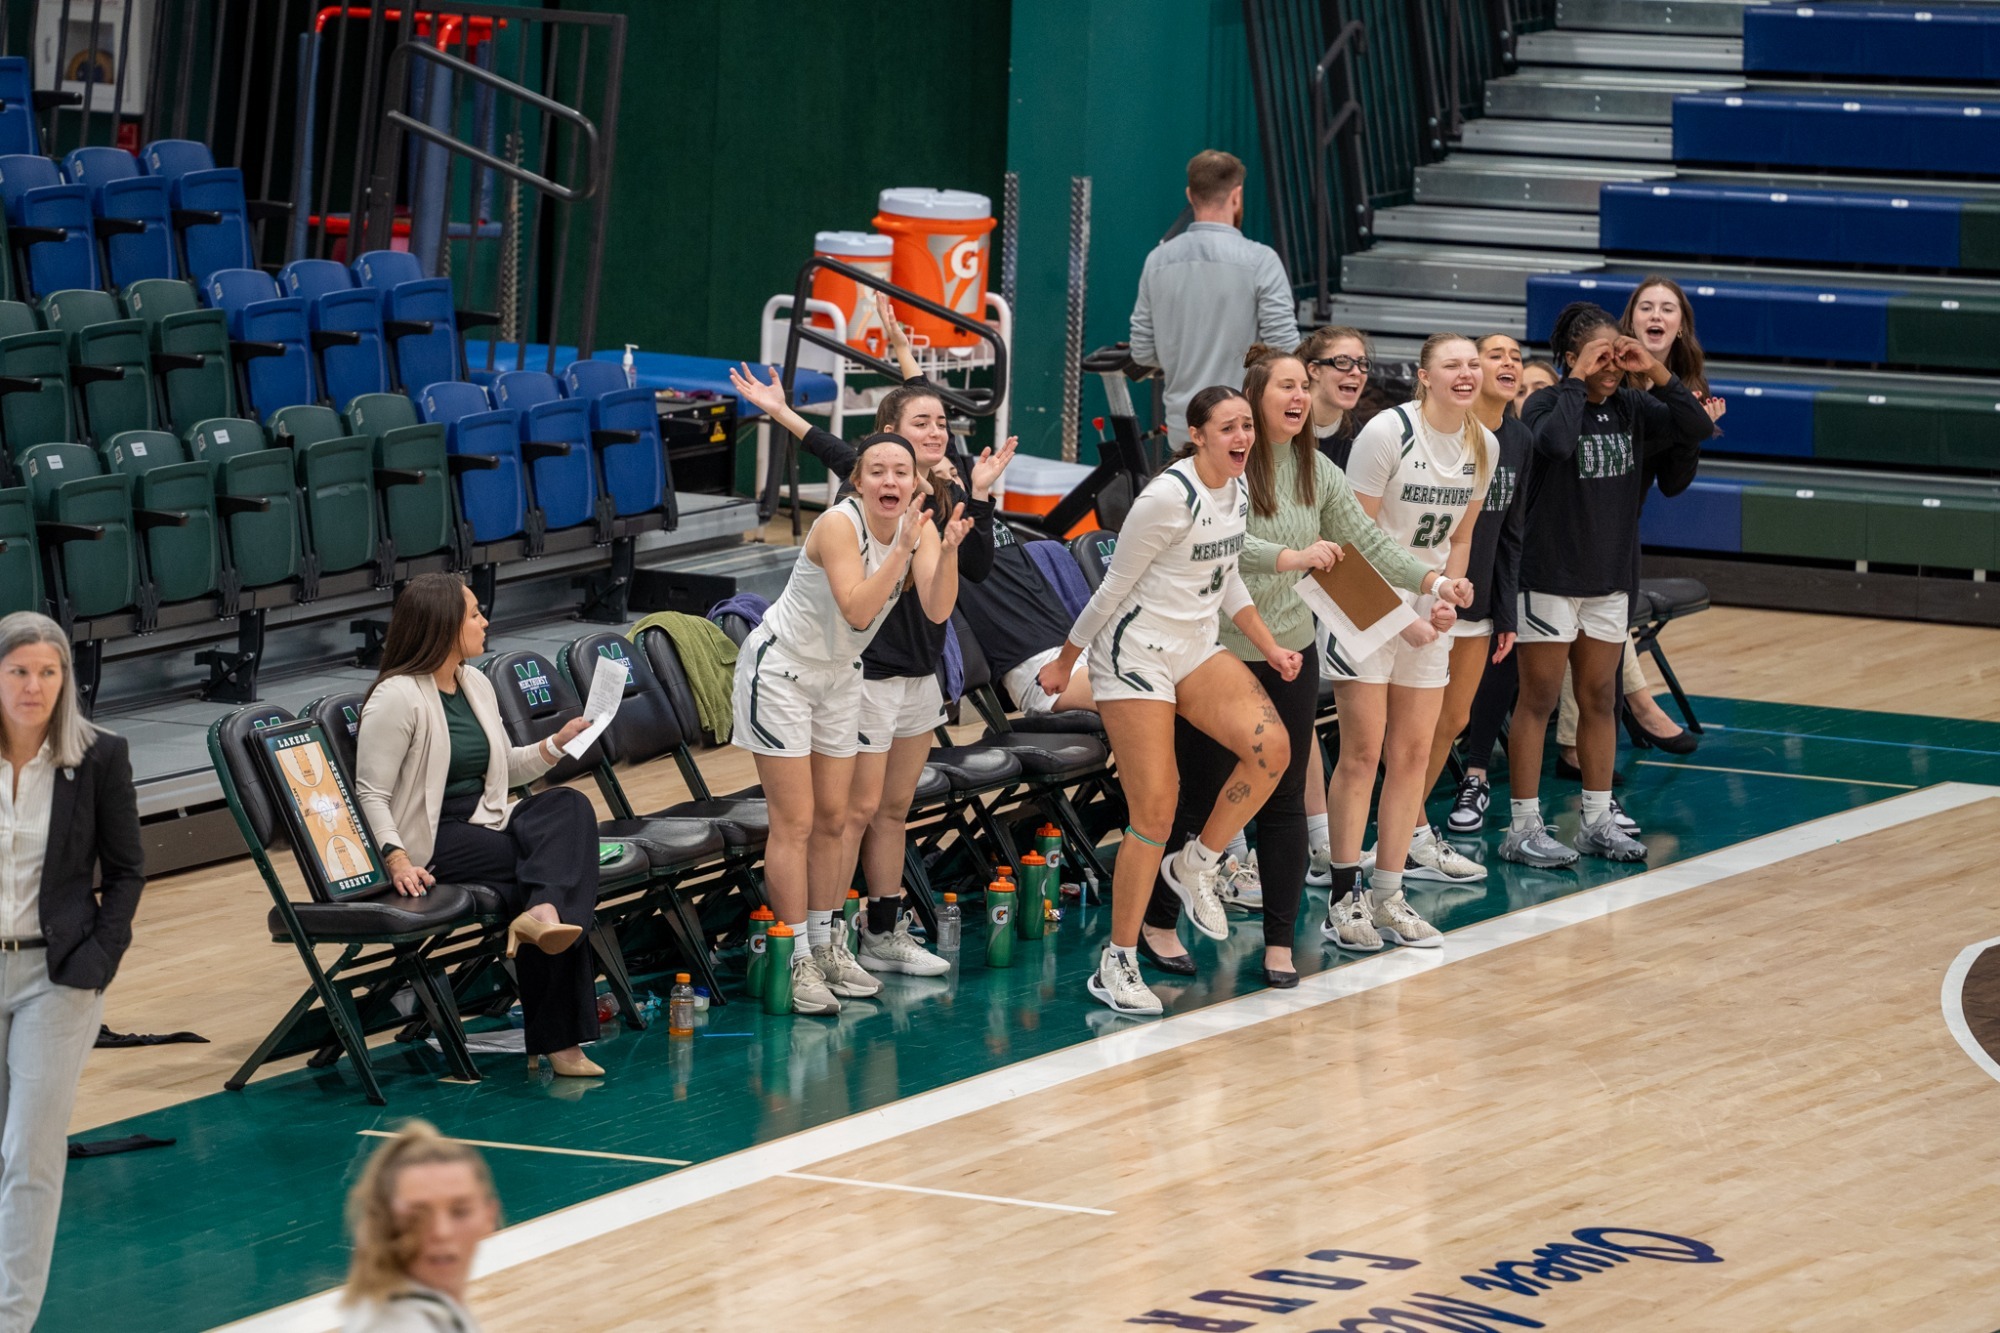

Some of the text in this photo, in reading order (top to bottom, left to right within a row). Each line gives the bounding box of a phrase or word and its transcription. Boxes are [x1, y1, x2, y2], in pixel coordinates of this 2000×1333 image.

[951, 241, 979, 279] G
[1410, 512, 1453, 549] 23
[277, 733, 311, 748] LAKERS
[328, 760, 371, 849] MERCYHURST
[1046, 849, 1060, 868] G
[338, 874, 373, 890] LAKERS
[991, 905, 1009, 925] G
[750, 934, 767, 954] G
[1460, 1227, 1724, 1296] Owen
